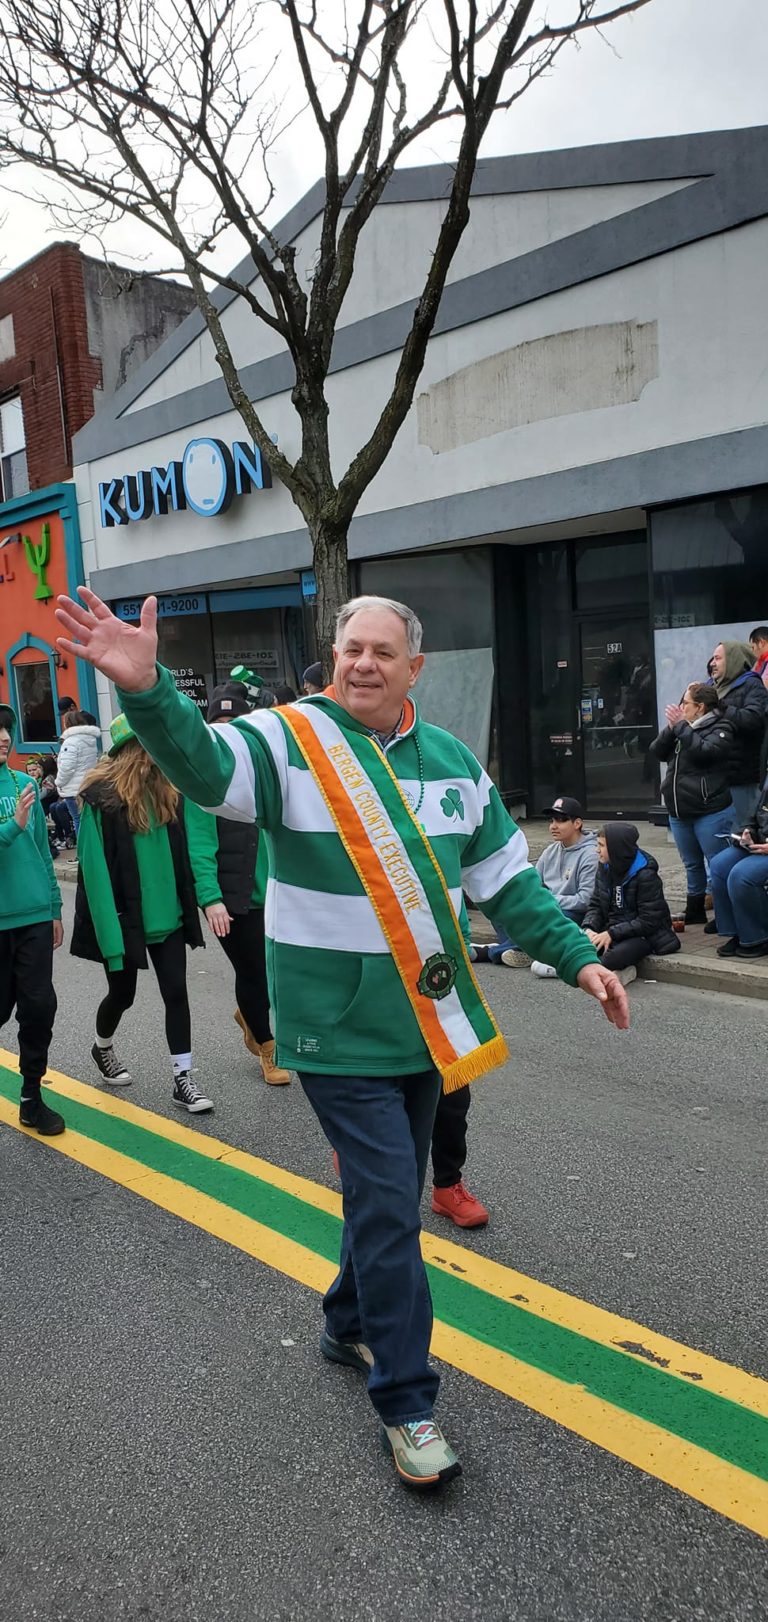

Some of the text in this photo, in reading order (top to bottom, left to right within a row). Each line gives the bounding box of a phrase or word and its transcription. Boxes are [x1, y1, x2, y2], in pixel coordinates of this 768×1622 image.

[98, 437, 272, 528] KUMON
[123, 598, 199, 616] 5511-9200
[171, 668, 194, 677] RLD'S
[175, 678, 205, 688] ESSFUL
[180, 689, 198, 698] OOL
[327, 744, 423, 915] BERGEN COUNTY EXECUTIVE
